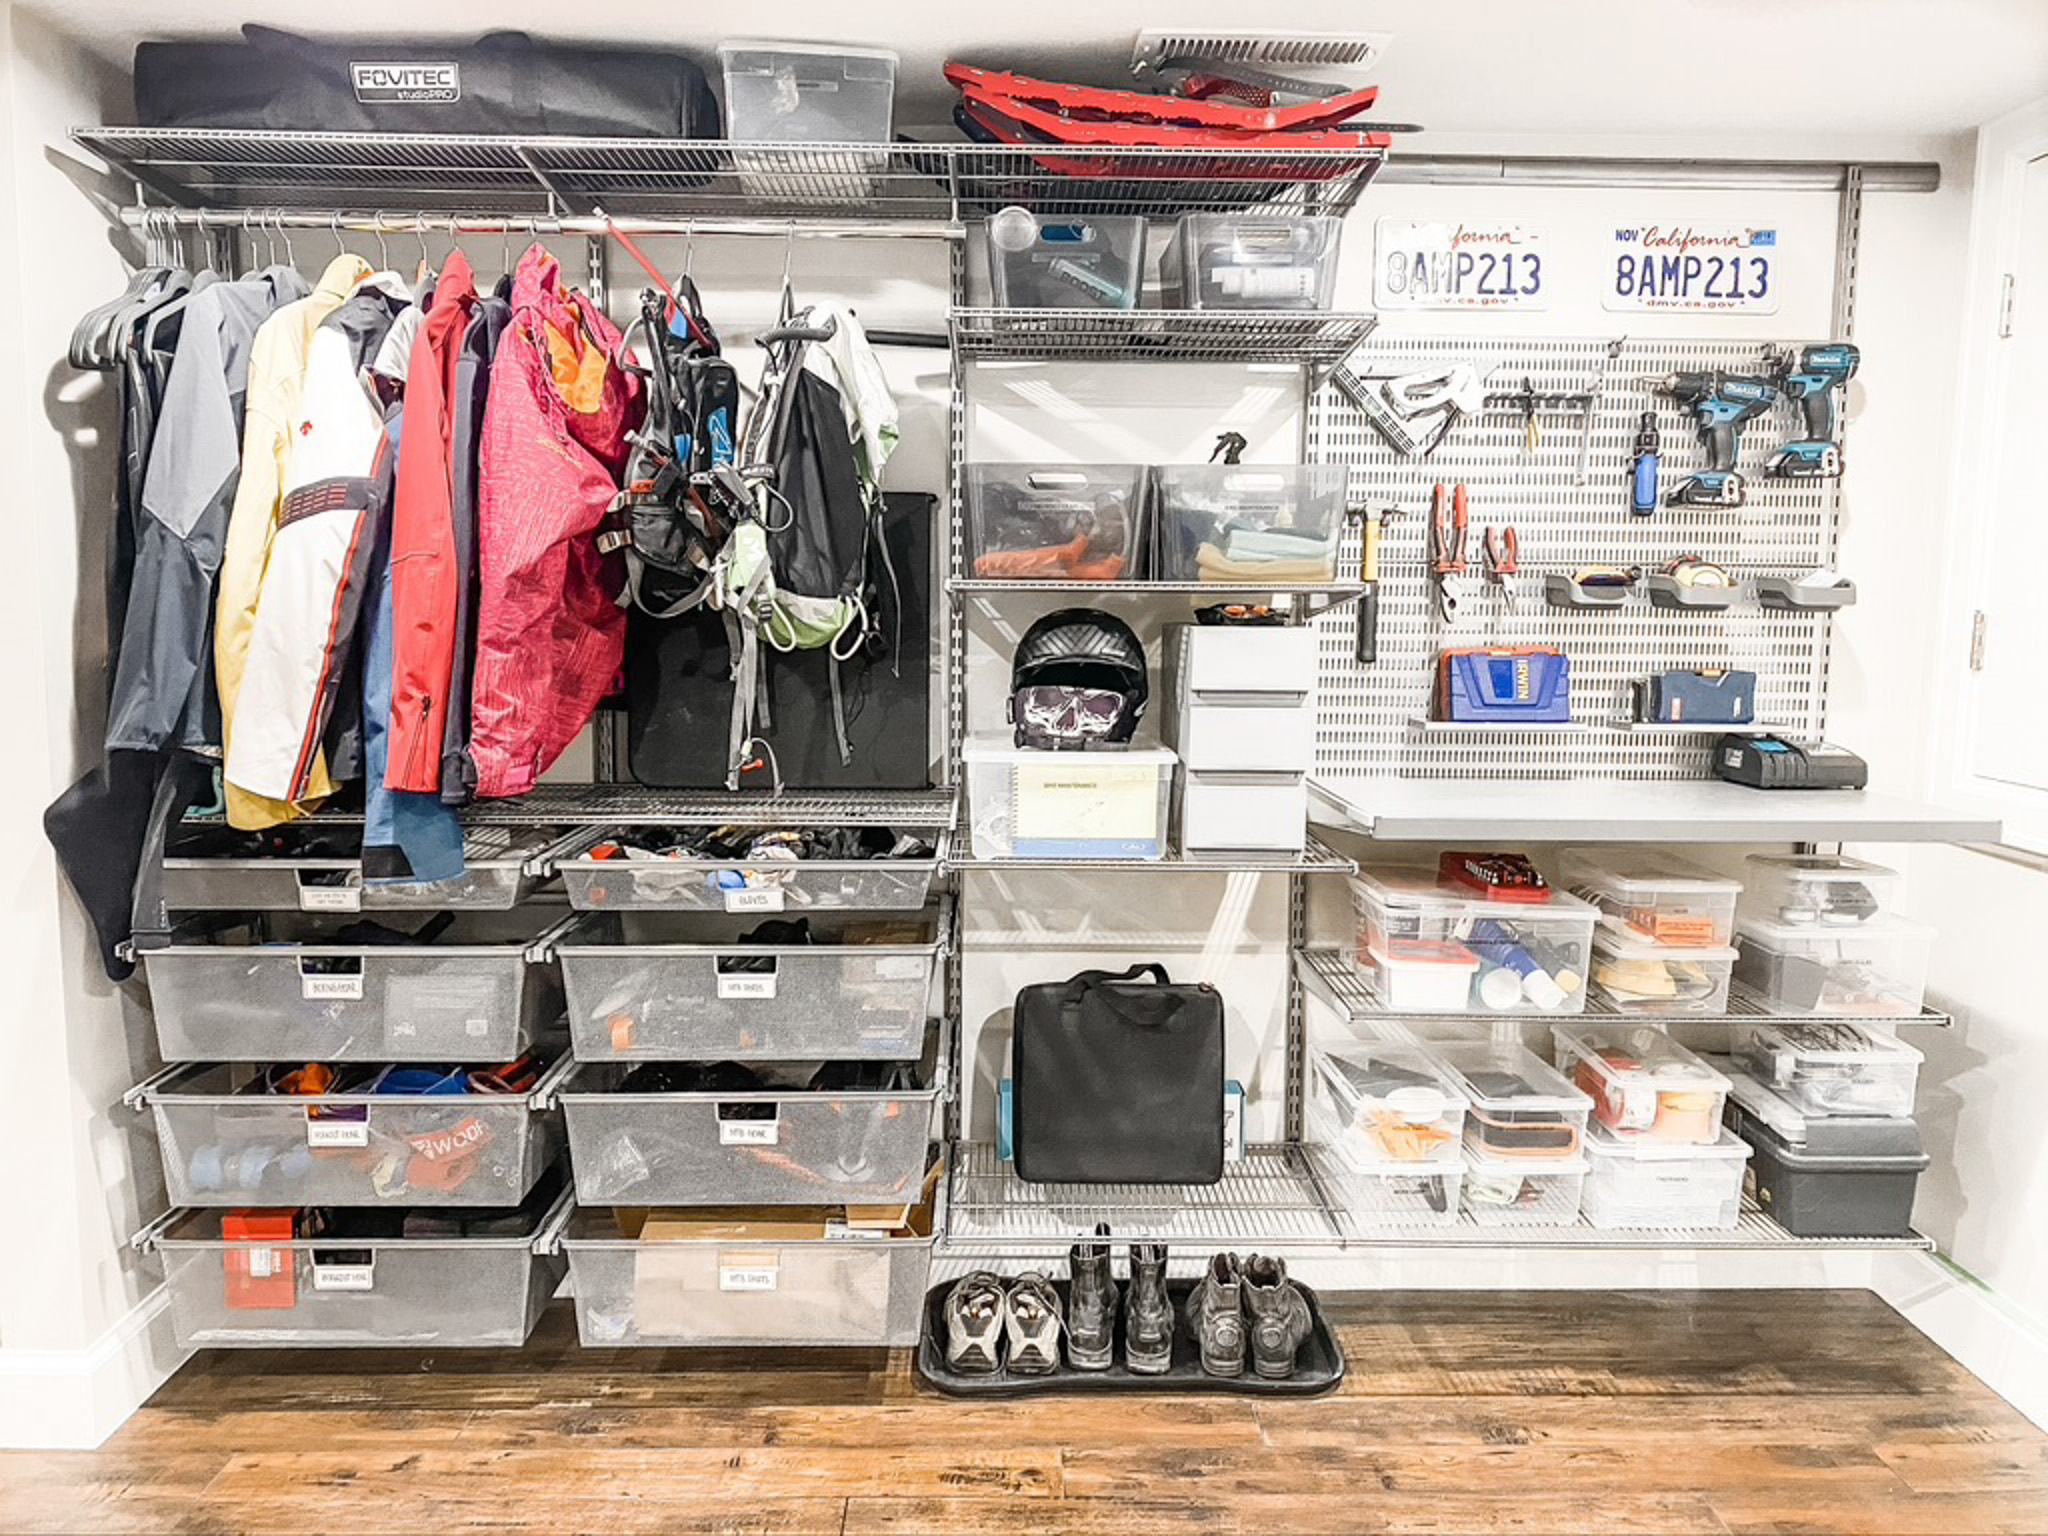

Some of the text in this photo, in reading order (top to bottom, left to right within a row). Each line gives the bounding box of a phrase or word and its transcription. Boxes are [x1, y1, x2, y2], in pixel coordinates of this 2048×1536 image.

[357, 69, 452, 87] FOVITEC
[396, 88, 454, 100] studioPRO
[1615, 228, 1640, 243] NOV
[1642, 225, 1750, 254] California
[1387, 251, 1541, 295] 8AMP213
[1615, 254, 1769, 299] 8AMP213
[1646, 299, 1737, 309] dmv.ca.gov
[1517, 658, 1529, 699] IRWIN
